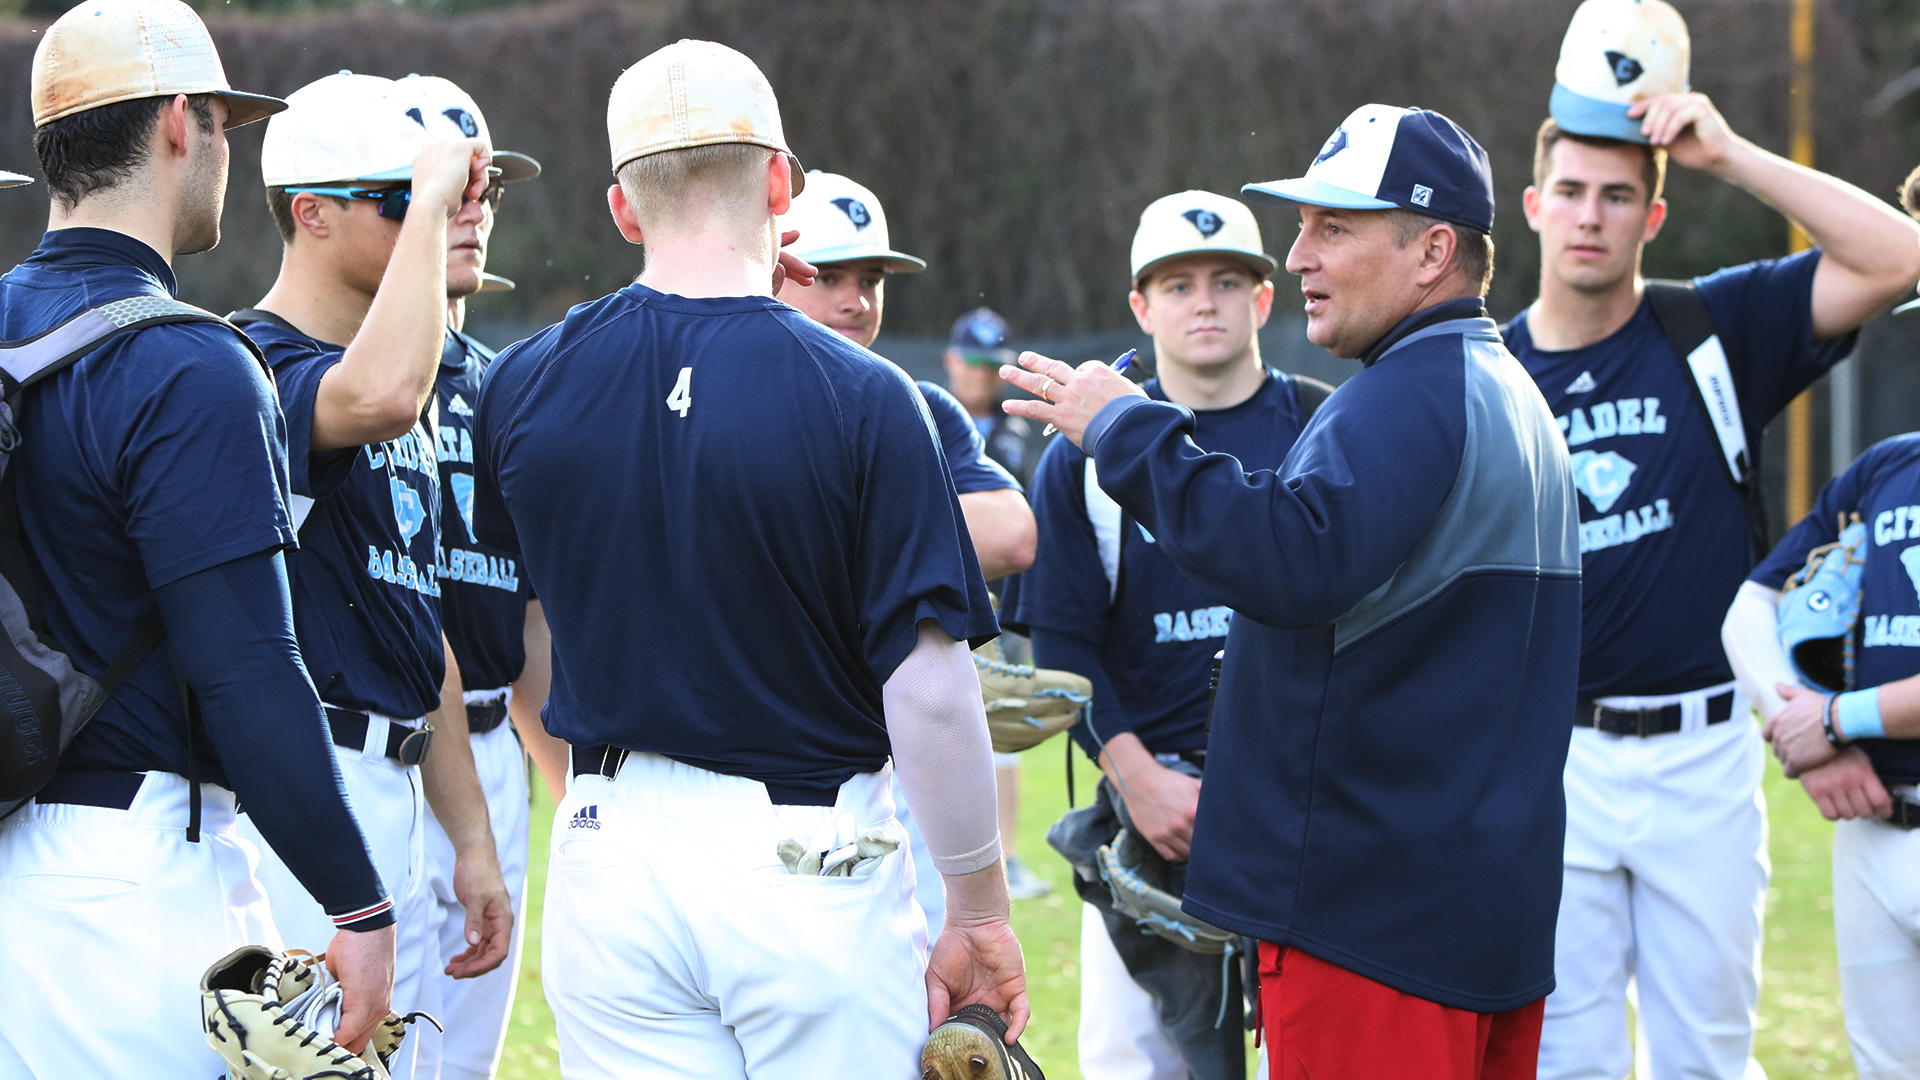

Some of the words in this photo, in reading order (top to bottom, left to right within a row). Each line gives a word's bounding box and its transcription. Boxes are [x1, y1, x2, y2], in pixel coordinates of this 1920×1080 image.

[1615, 58, 1635, 80] C
[848, 201, 866, 224] C
[1197, 211, 1216, 233] C
[665, 366, 693, 418] 4
[1585, 459, 1618, 497] C
[437, 546, 519, 593] ASEBALL
[1153, 605, 1234, 644] BASE
